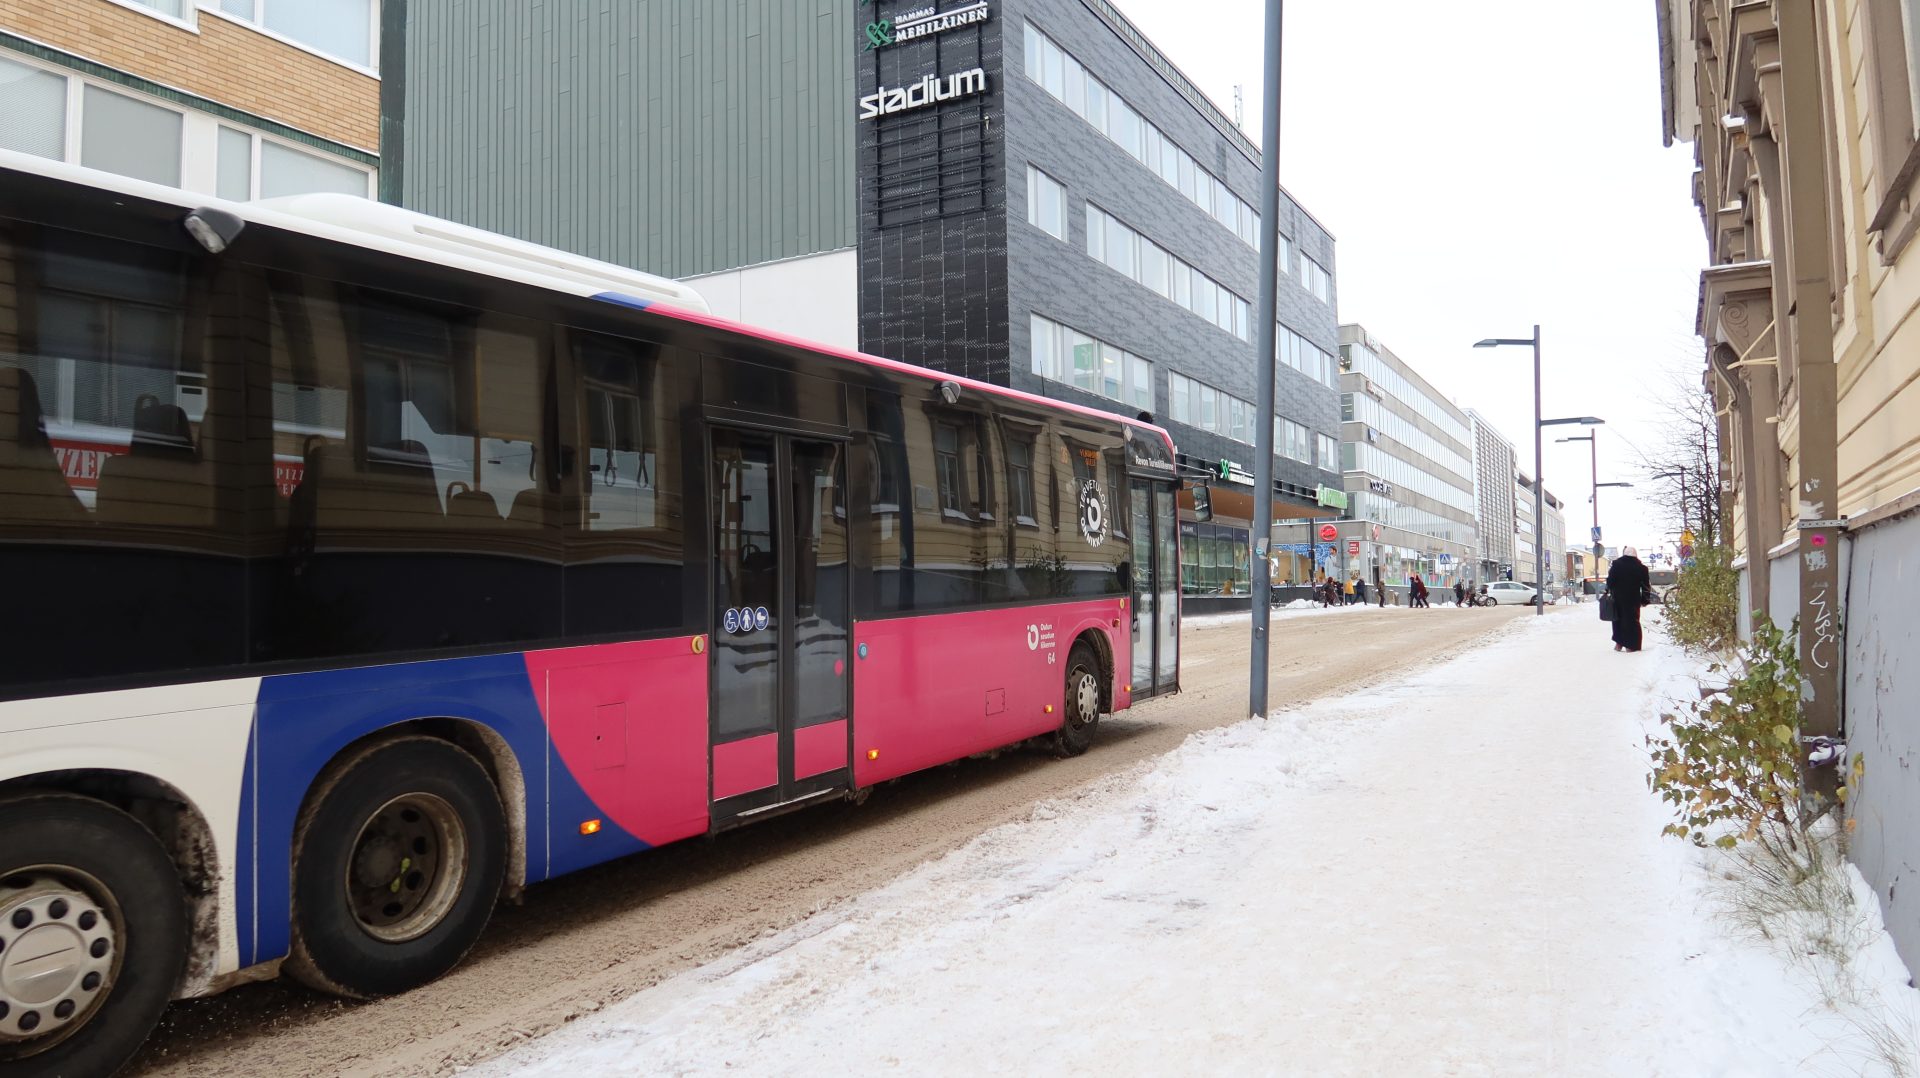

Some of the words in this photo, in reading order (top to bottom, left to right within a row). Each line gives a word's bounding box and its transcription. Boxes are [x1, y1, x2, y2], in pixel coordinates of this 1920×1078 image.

[895, 8, 988, 43] MEHILÄINEN
[859, 67, 985, 120] stadium
[1080, 479, 1107, 511] TERVETULOA
[1047, 652, 1056, 664] 64
